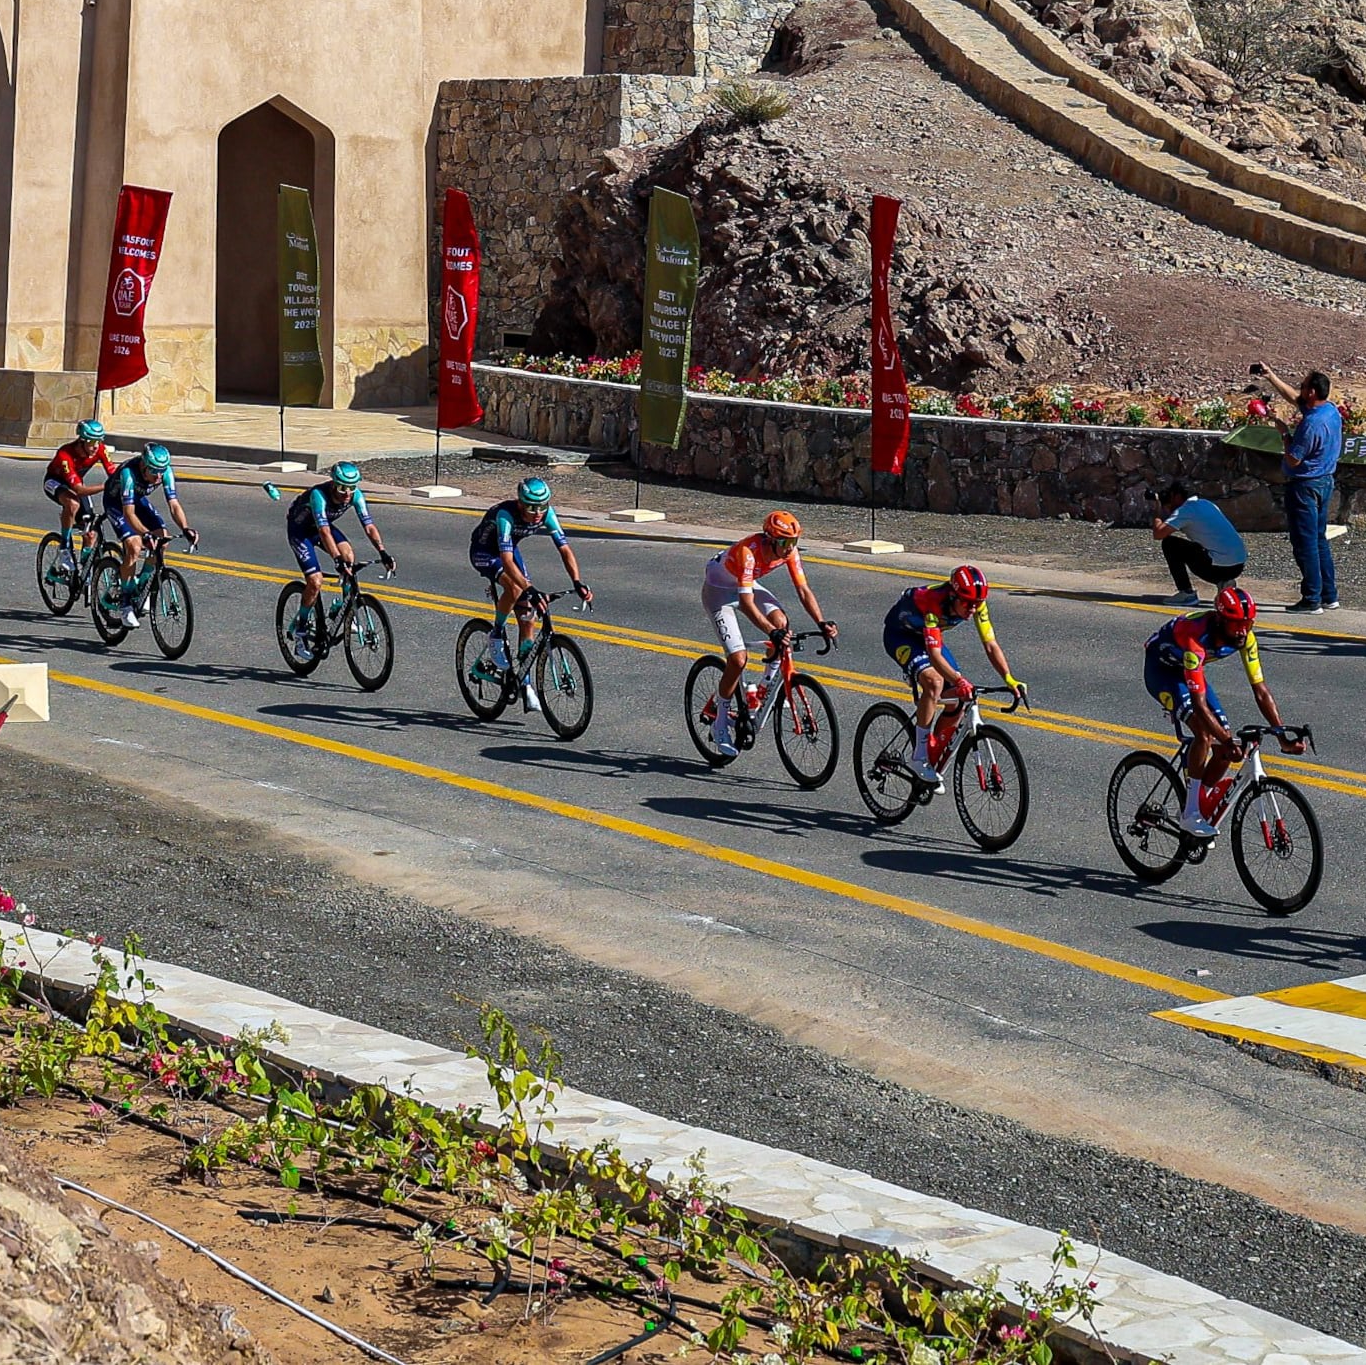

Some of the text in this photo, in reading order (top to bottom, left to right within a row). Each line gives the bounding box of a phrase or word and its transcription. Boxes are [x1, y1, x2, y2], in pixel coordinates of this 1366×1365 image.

[658, 290, 675, 302] BEST
[283, 308, 298, 317] THE
[294, 320, 316, 329] 2025
[660, 333, 685, 345] WORL
